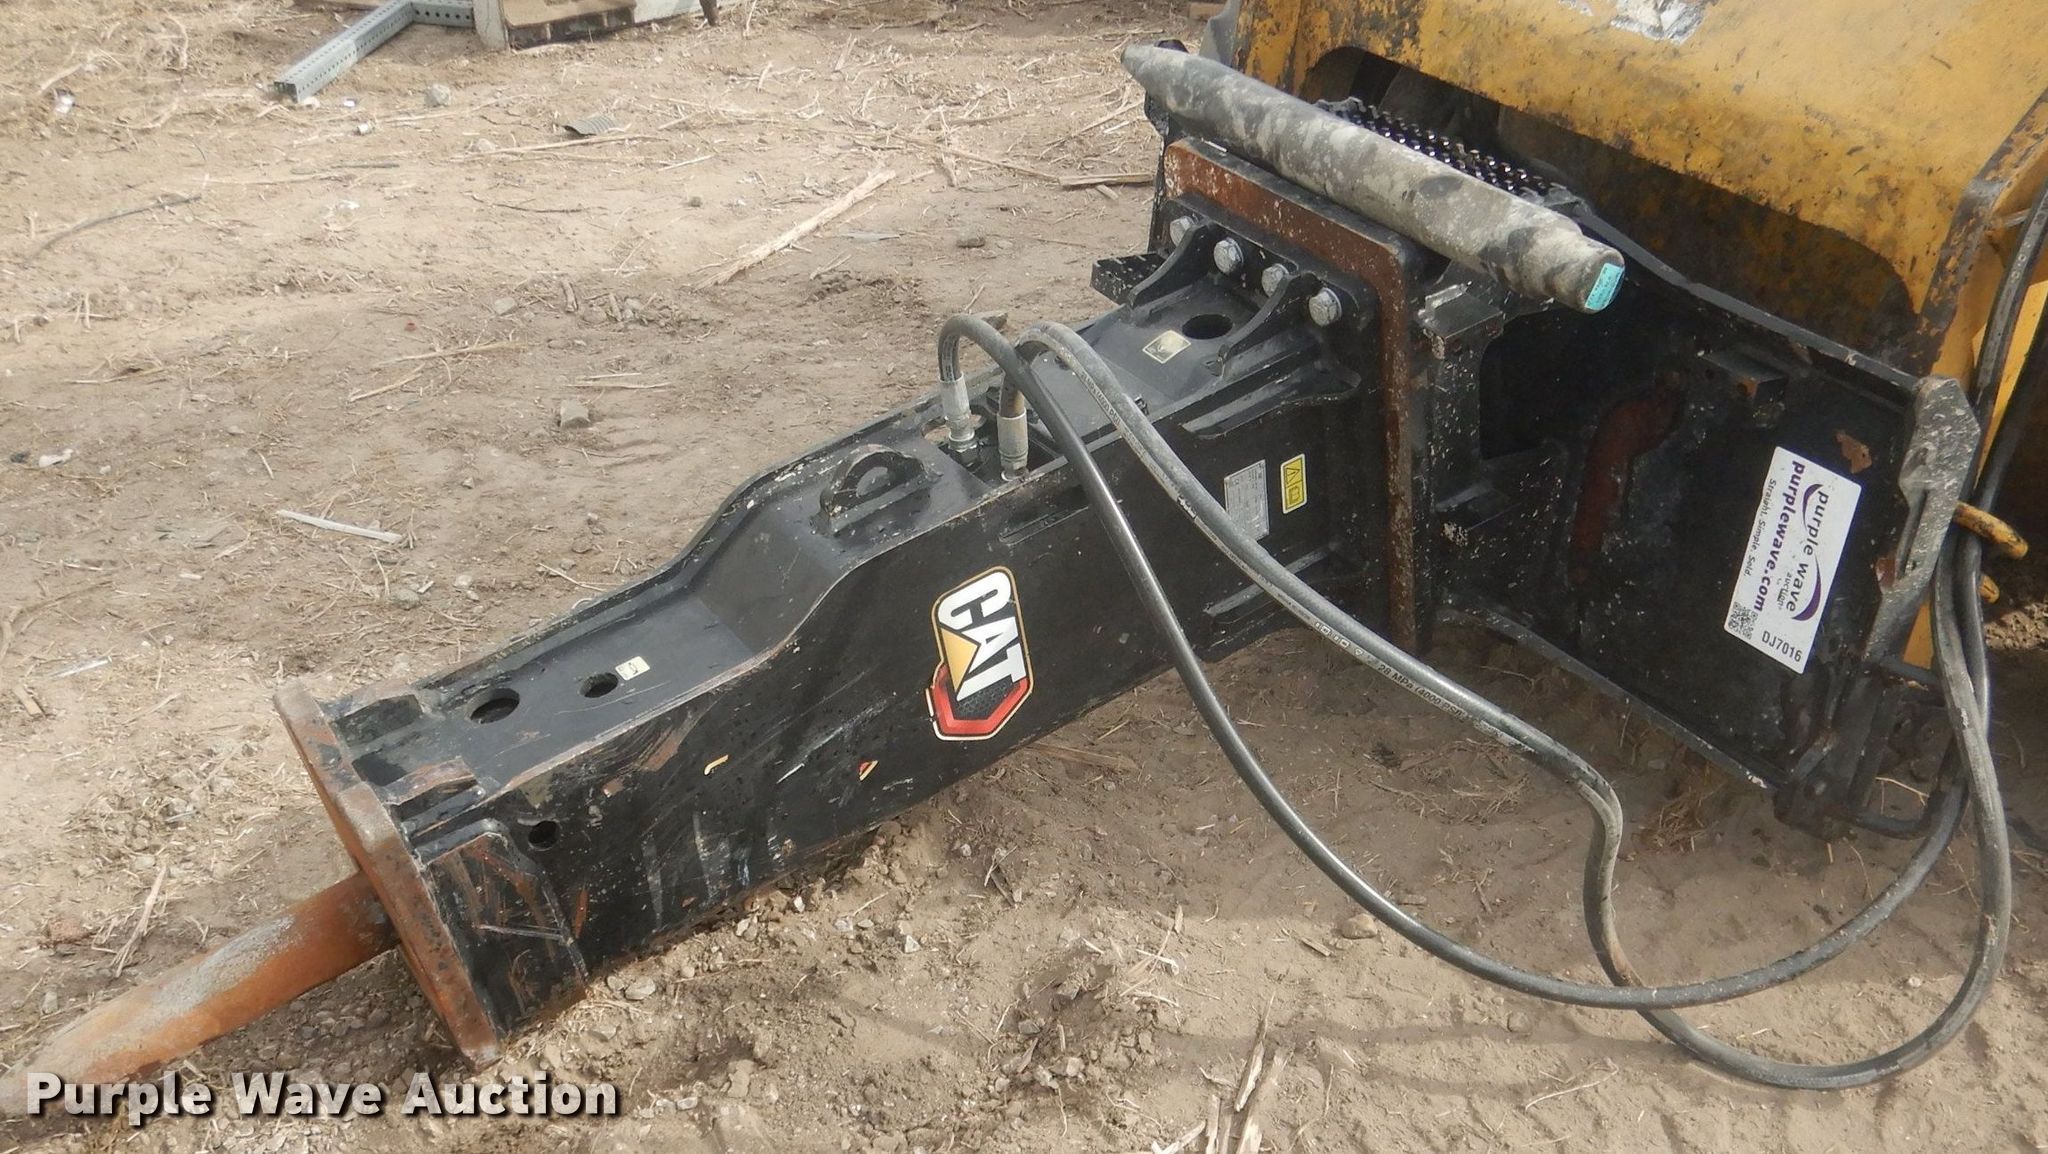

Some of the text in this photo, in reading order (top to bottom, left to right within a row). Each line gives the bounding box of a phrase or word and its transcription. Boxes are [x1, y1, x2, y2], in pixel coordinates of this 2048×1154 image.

[1754, 460, 1806, 612] purplewave.com
[1786, 490, 1829, 612] purple wave
[938, 571, 1027, 701] CAT
[1378, 664, 1392, 676] 28
[1392, 672, 1414, 689] MPa
[1761, 630, 1803, 662] DJ7016
